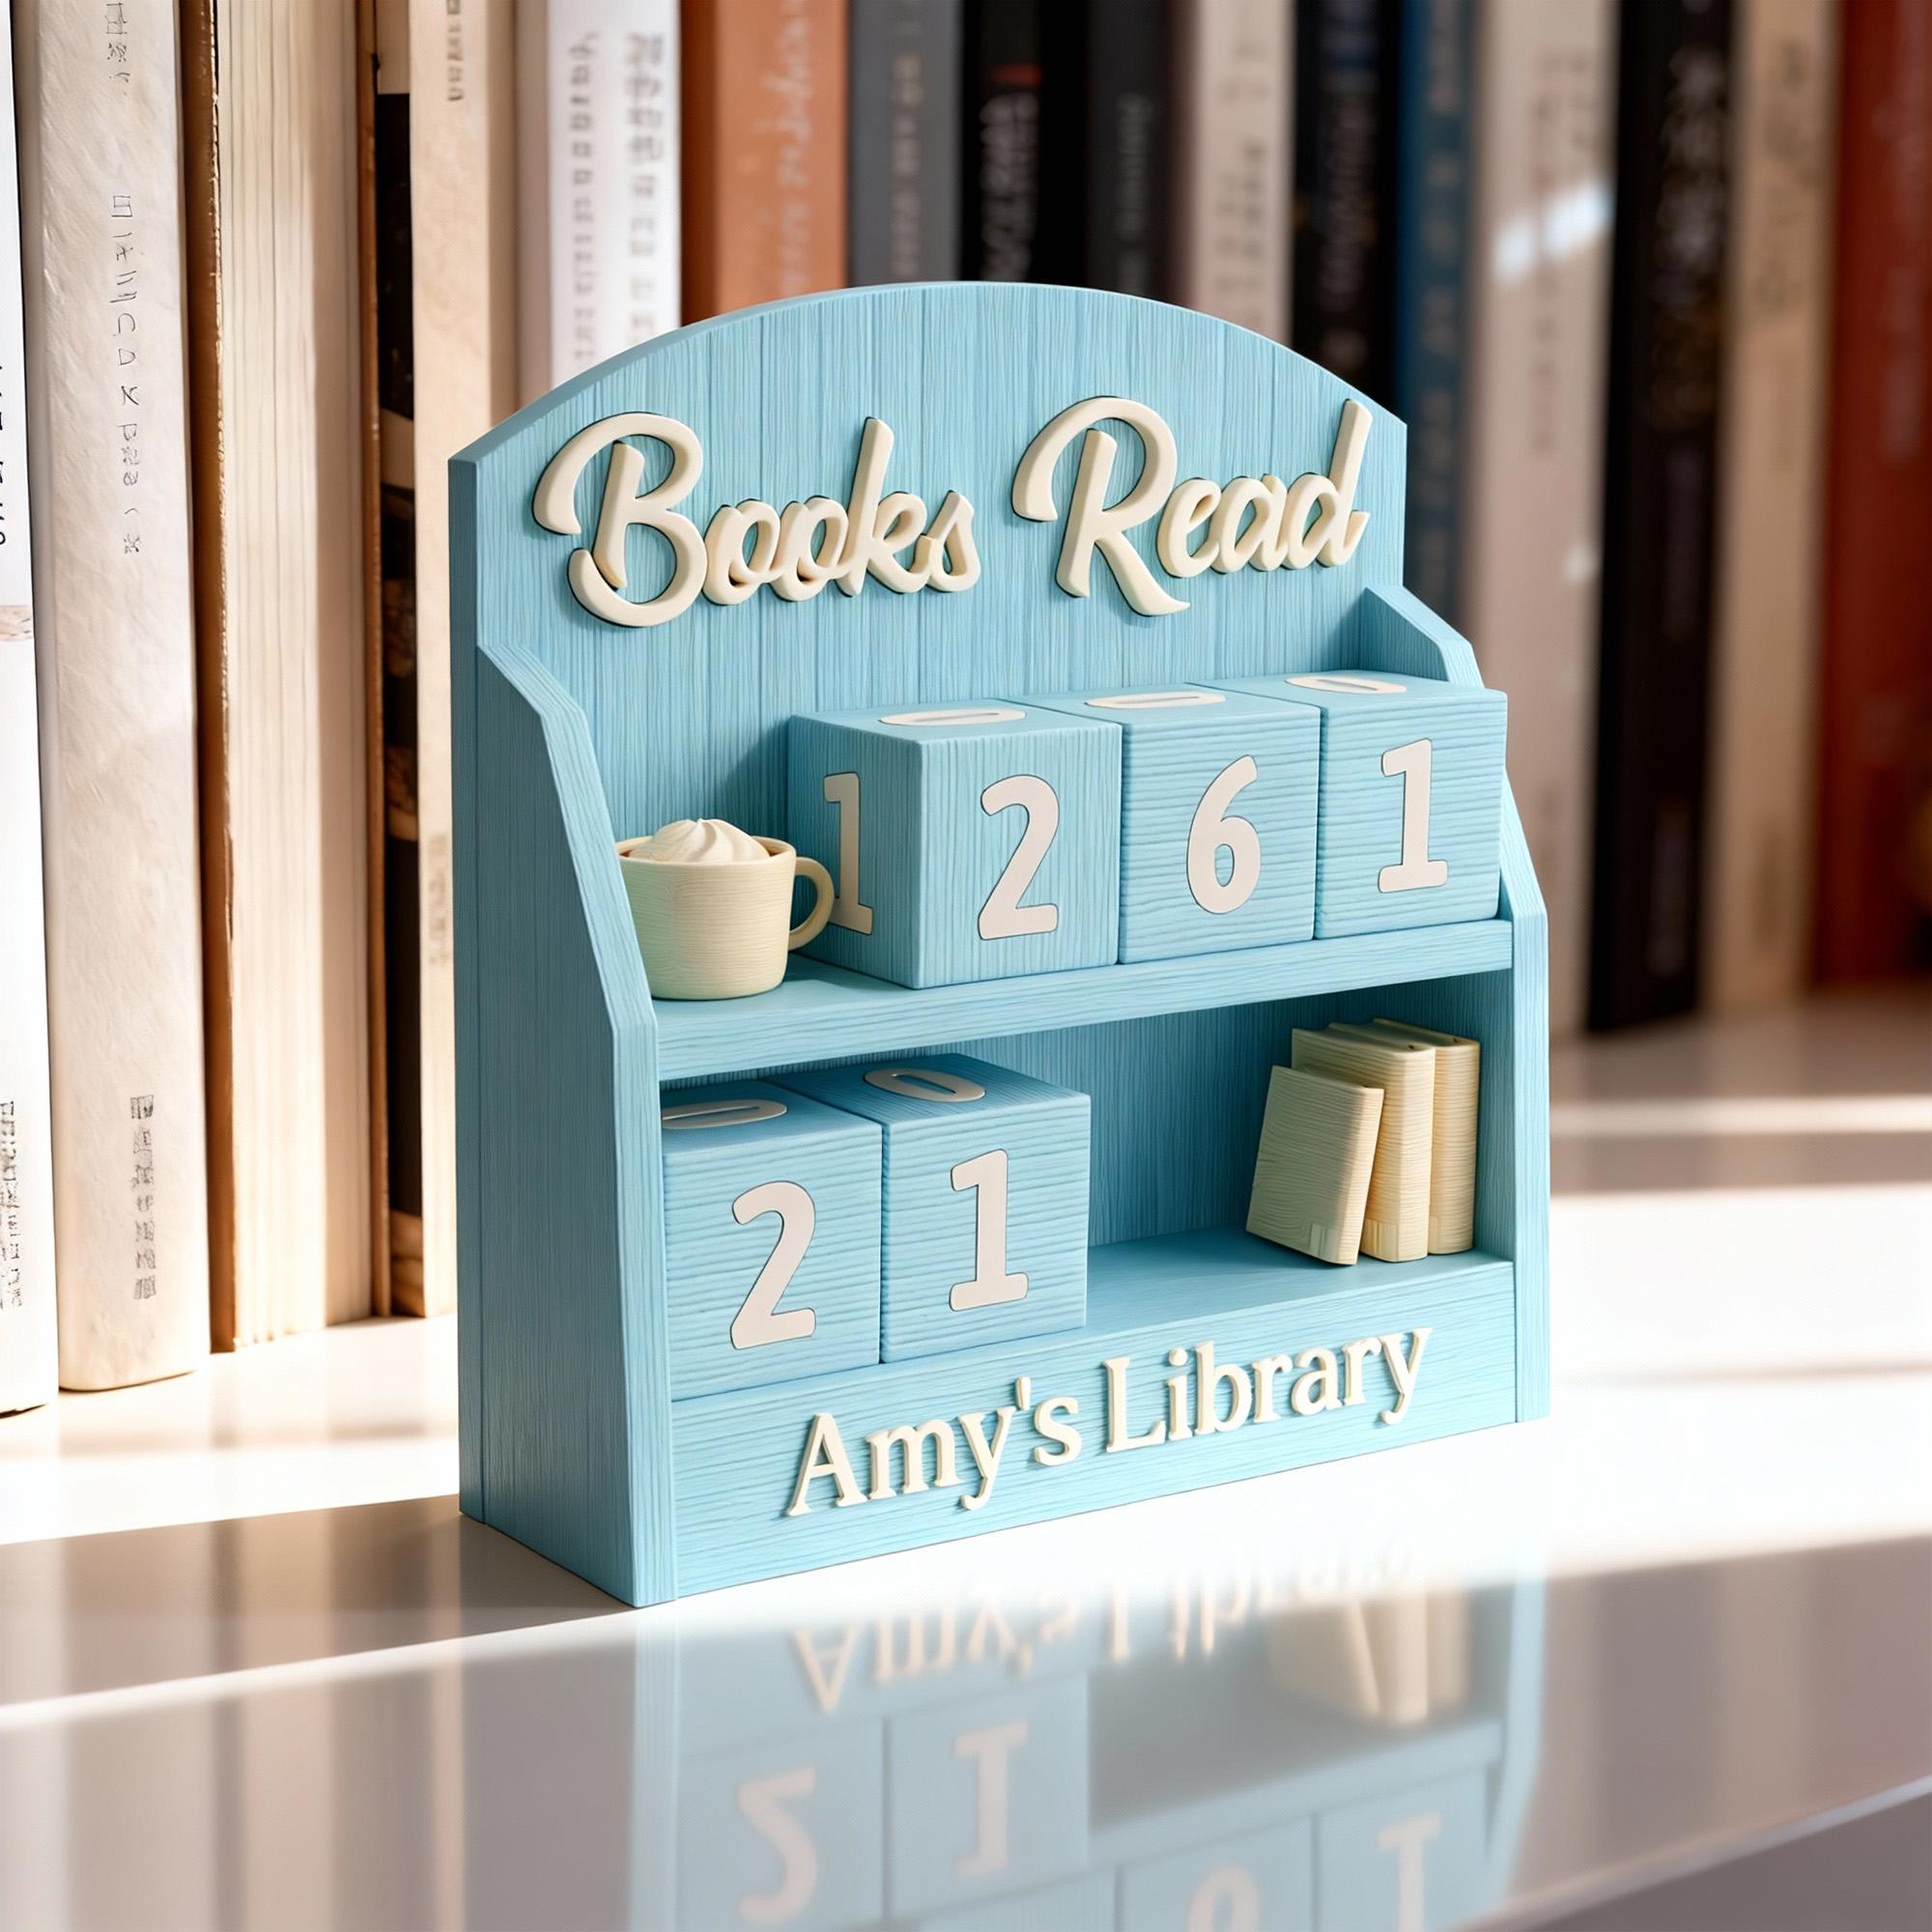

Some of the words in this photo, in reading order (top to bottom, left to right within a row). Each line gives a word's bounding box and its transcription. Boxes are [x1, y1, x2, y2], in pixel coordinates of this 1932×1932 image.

[533, 412, 980, 627] Books
[1012, 396, 1371, 616] Read
[824, 772, 873, 935] 1
[788, 1377, 1082, 1516] Amy's
[1104, 1327, 1433, 1452] Library
